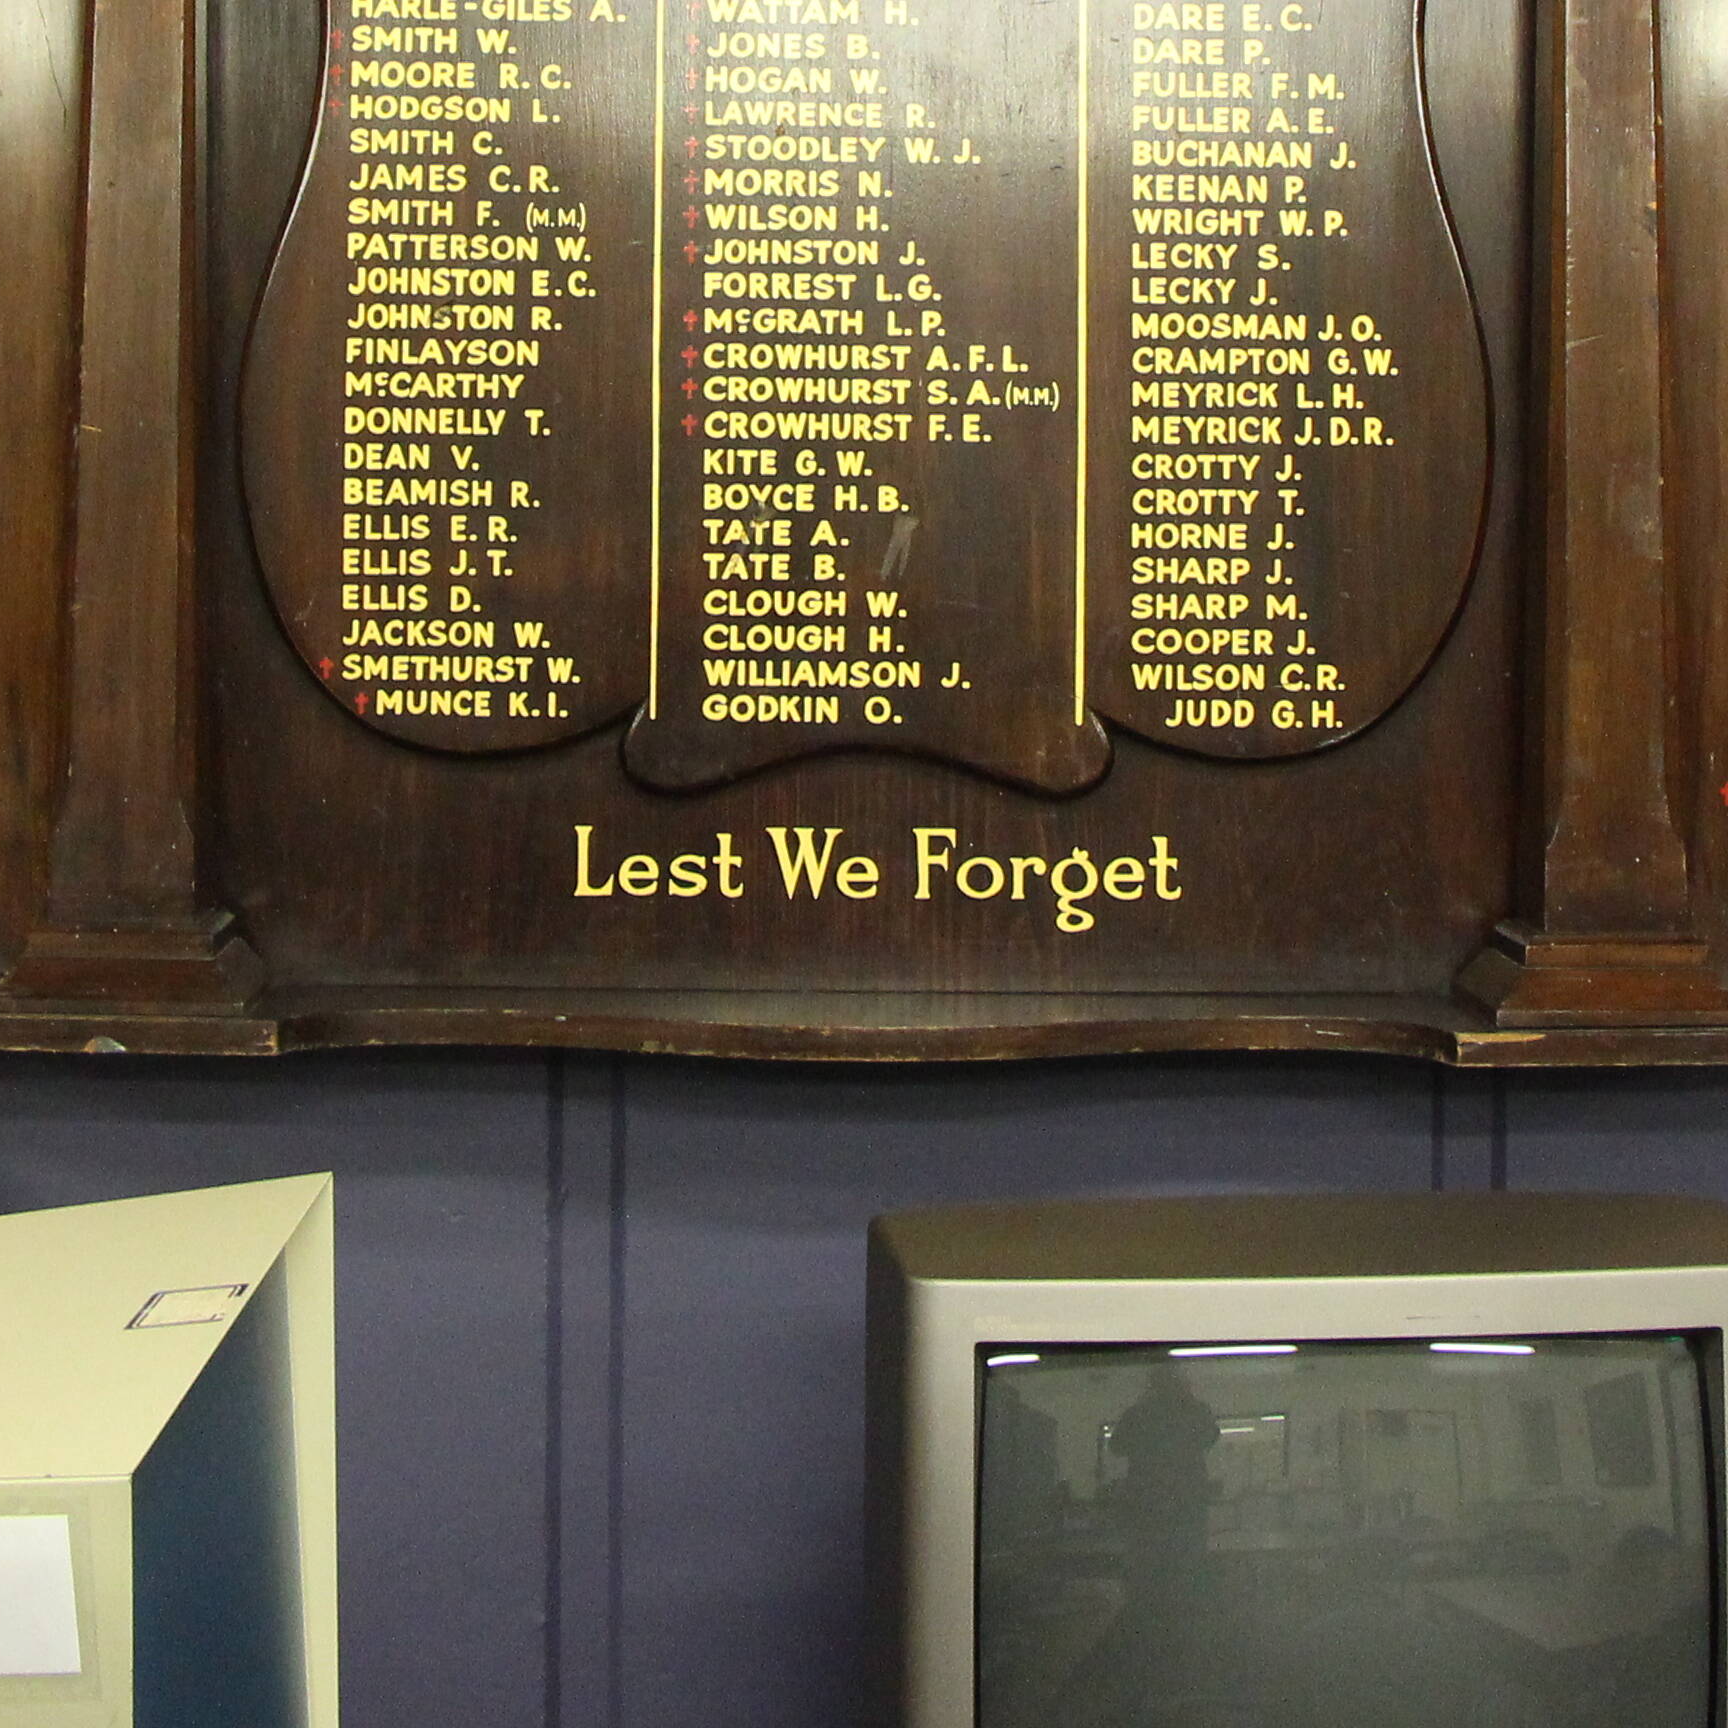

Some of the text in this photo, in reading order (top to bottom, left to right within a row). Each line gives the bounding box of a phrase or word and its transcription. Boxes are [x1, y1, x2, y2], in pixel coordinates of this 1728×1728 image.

[885, 0, 920, 25] H.
[352, 25, 517, 53] SMITH W.
[351, 95, 561, 122] HODGSON L.
[704, 100, 885, 128] LAWRENCE
[1132, 140, 1356, 168] BUCHANAN J.
[705, 204, 889, 230] WILSON H.
[1132, 243, 1291, 270] LECKY S.
[347, 338, 539, 365] FINLAYSON
[345, 407, 550, 434] DONNELLY T.
[1133, 489, 1305, 514] CROTTY T.
[704, 589, 907, 616] CLOUGH W.
[1132, 628, 1315, 654] COOPER J.
[342, 654, 581, 682] SMETHURST W.
[703, 694, 903, 723] GODKIN O.
[575, 826, 1181, 931] Lest We Forget
